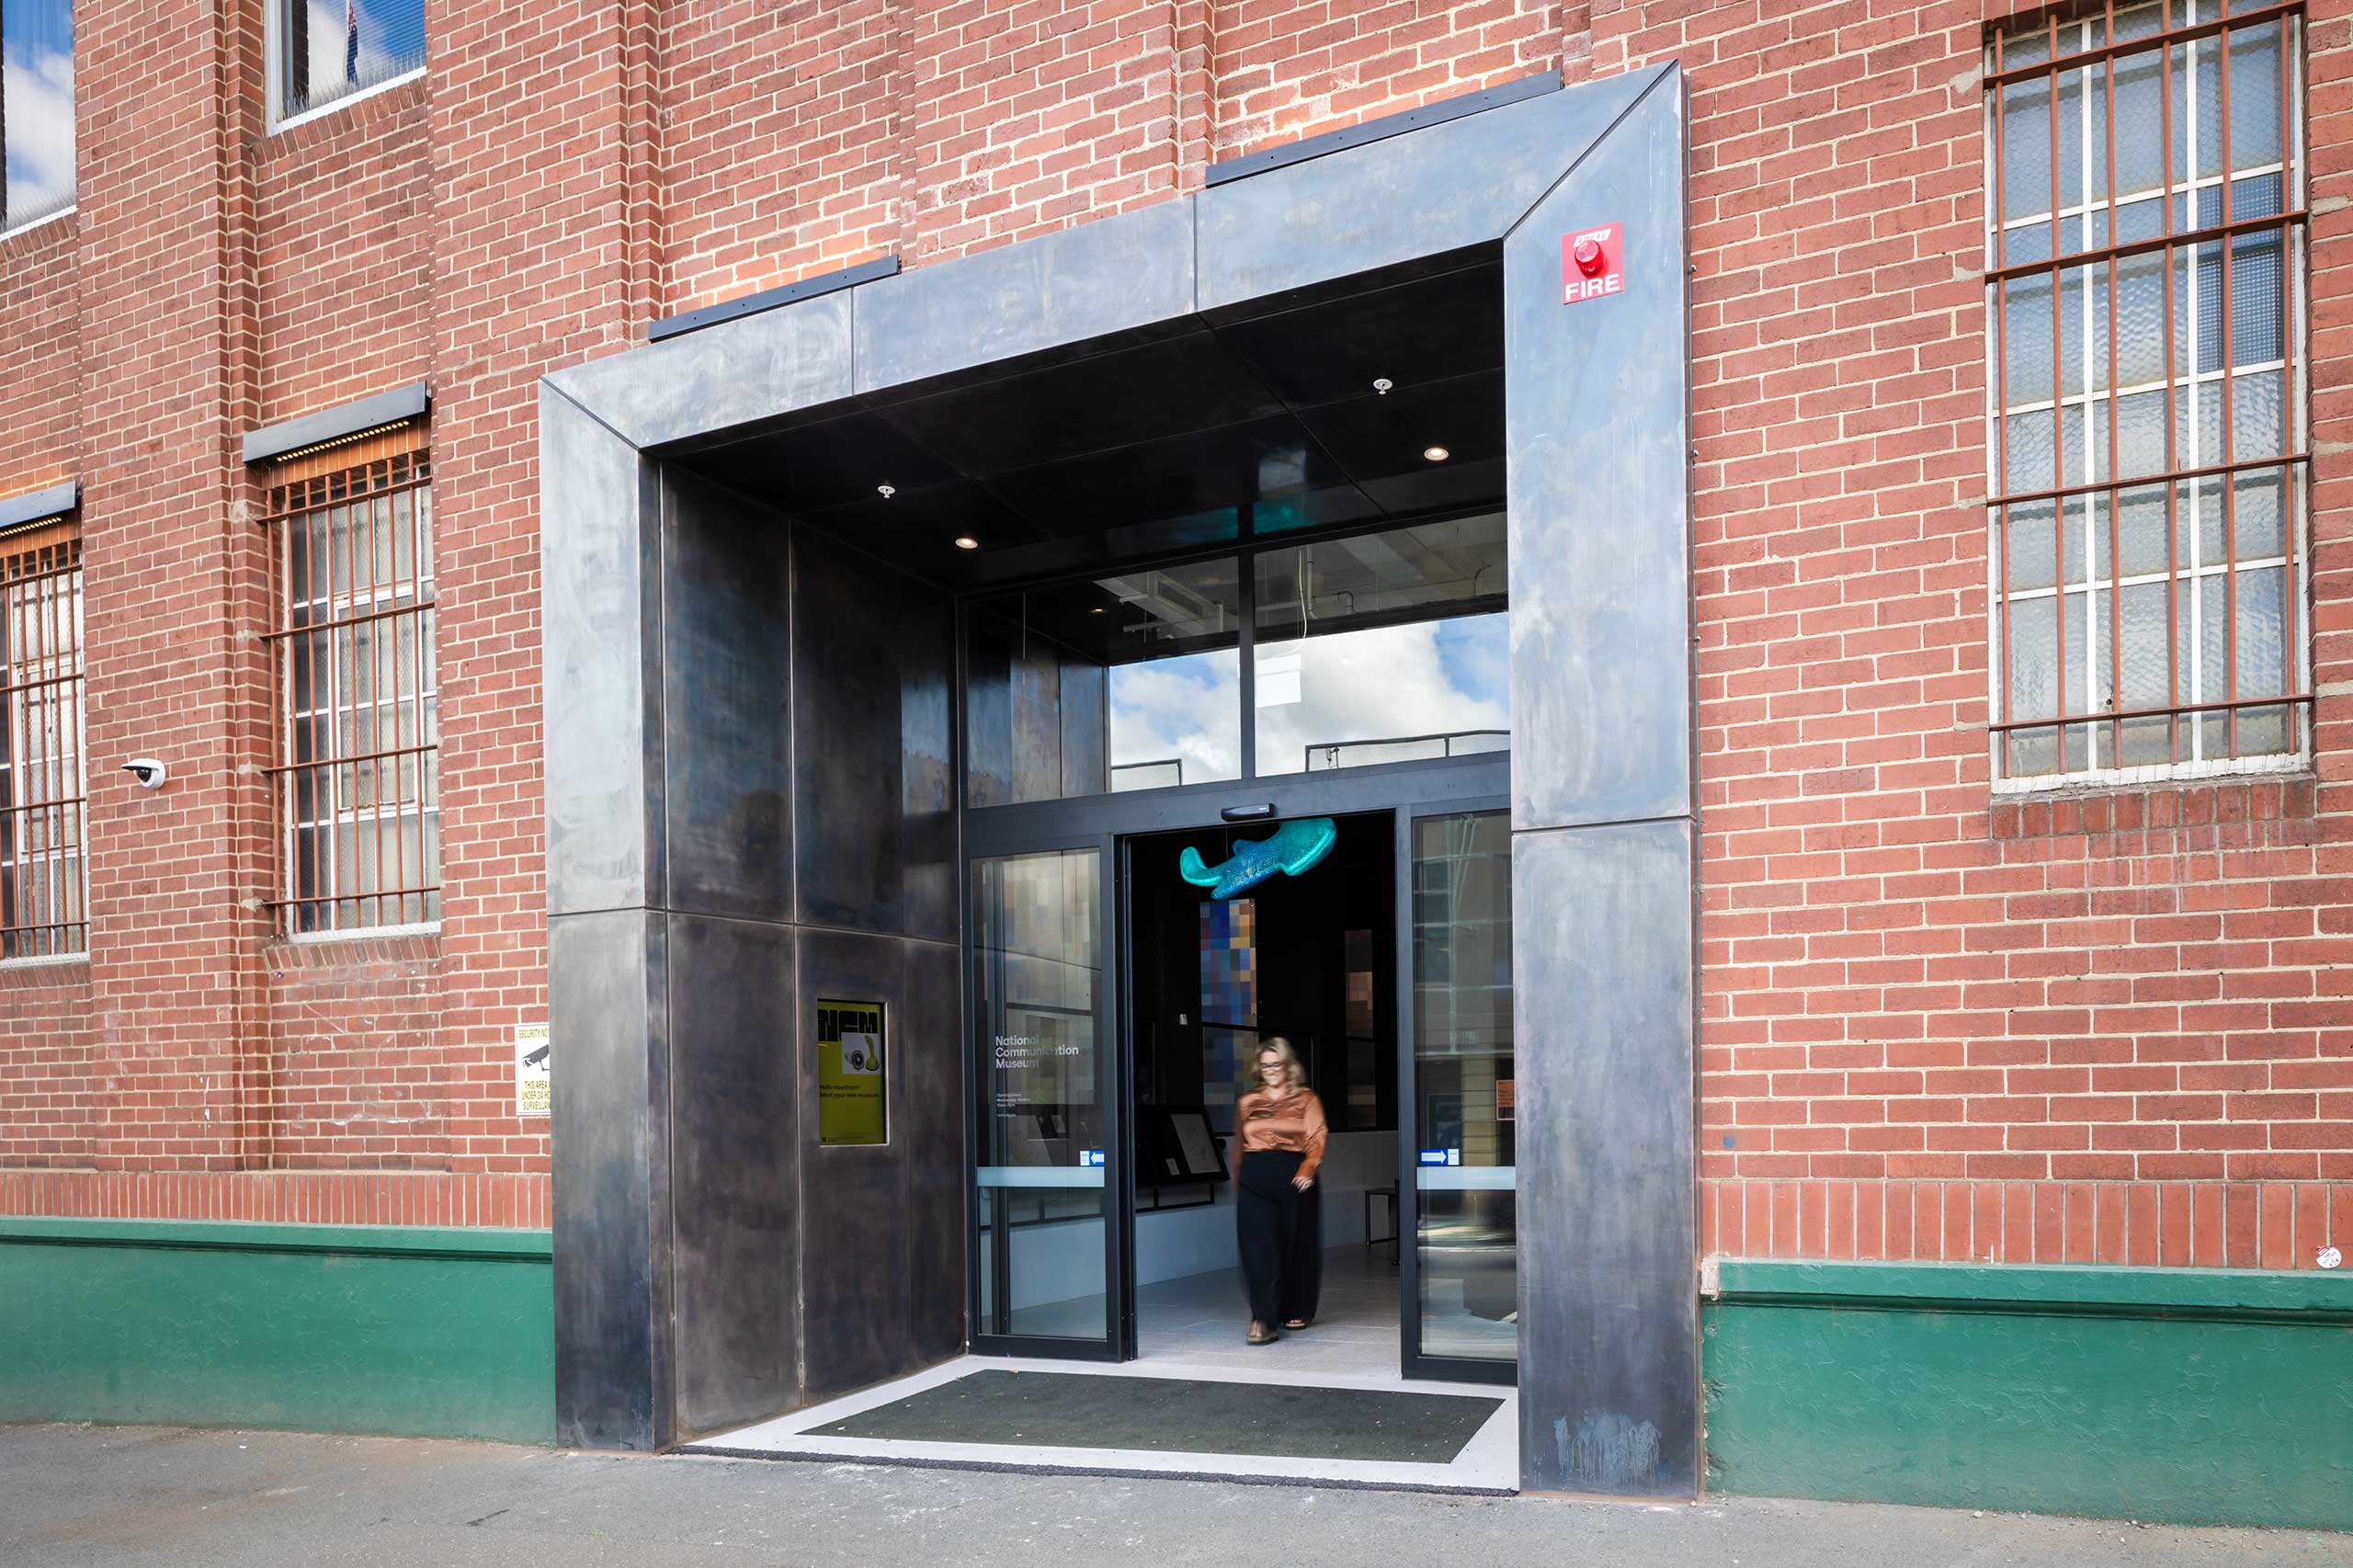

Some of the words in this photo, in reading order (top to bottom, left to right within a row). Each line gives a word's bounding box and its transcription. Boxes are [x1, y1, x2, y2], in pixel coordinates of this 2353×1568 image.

[1565, 273, 1620, 301] FIRE
[518, 1028, 540, 1039] SECURITY
[541, 1028, 551, 1038] NO
[995, 1035, 1040, 1047] National
[995, 1058, 1040, 1069] Museum
[525, 1080, 535, 1089] THIS
[536, 1080, 548, 1089] AREA
[521, 1091, 537, 1100] UNDER
[538, 1090, 543, 1100] 24
[522, 1101, 551, 1111] SURVEILLAN
